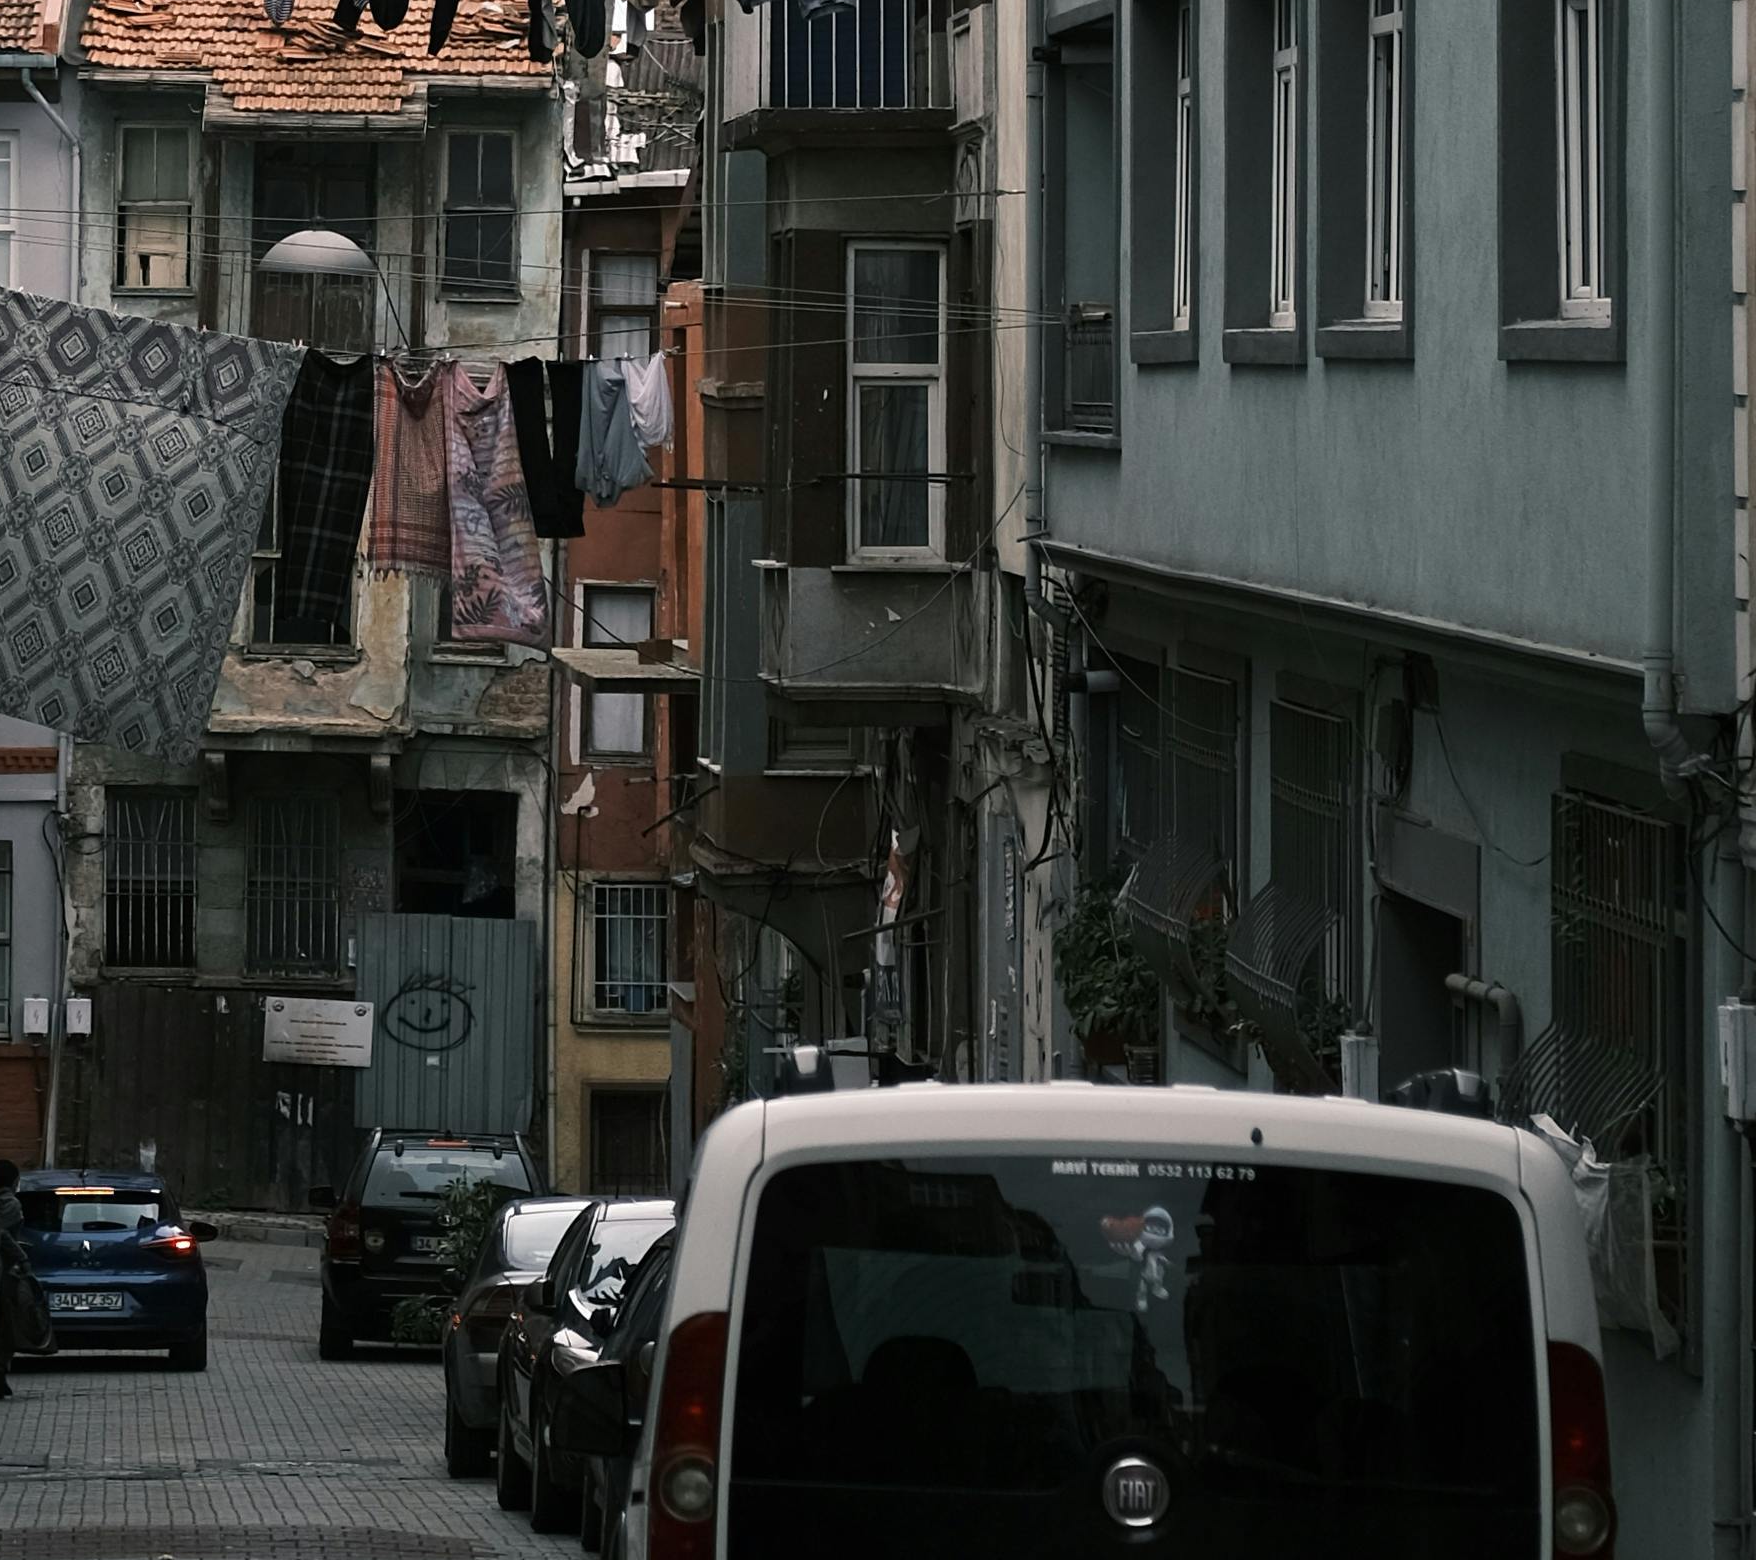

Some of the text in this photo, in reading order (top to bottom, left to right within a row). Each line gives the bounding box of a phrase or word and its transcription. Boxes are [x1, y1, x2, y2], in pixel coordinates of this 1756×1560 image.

[1147, 1163, 1183, 1178] 0532
[1187, 1164, 1213, 1179] 113
[1216, 1165, 1234, 1180] 62
[1238, 1166, 1257, 1181] 79
[1118, 1479, 1157, 1511] FIAT
